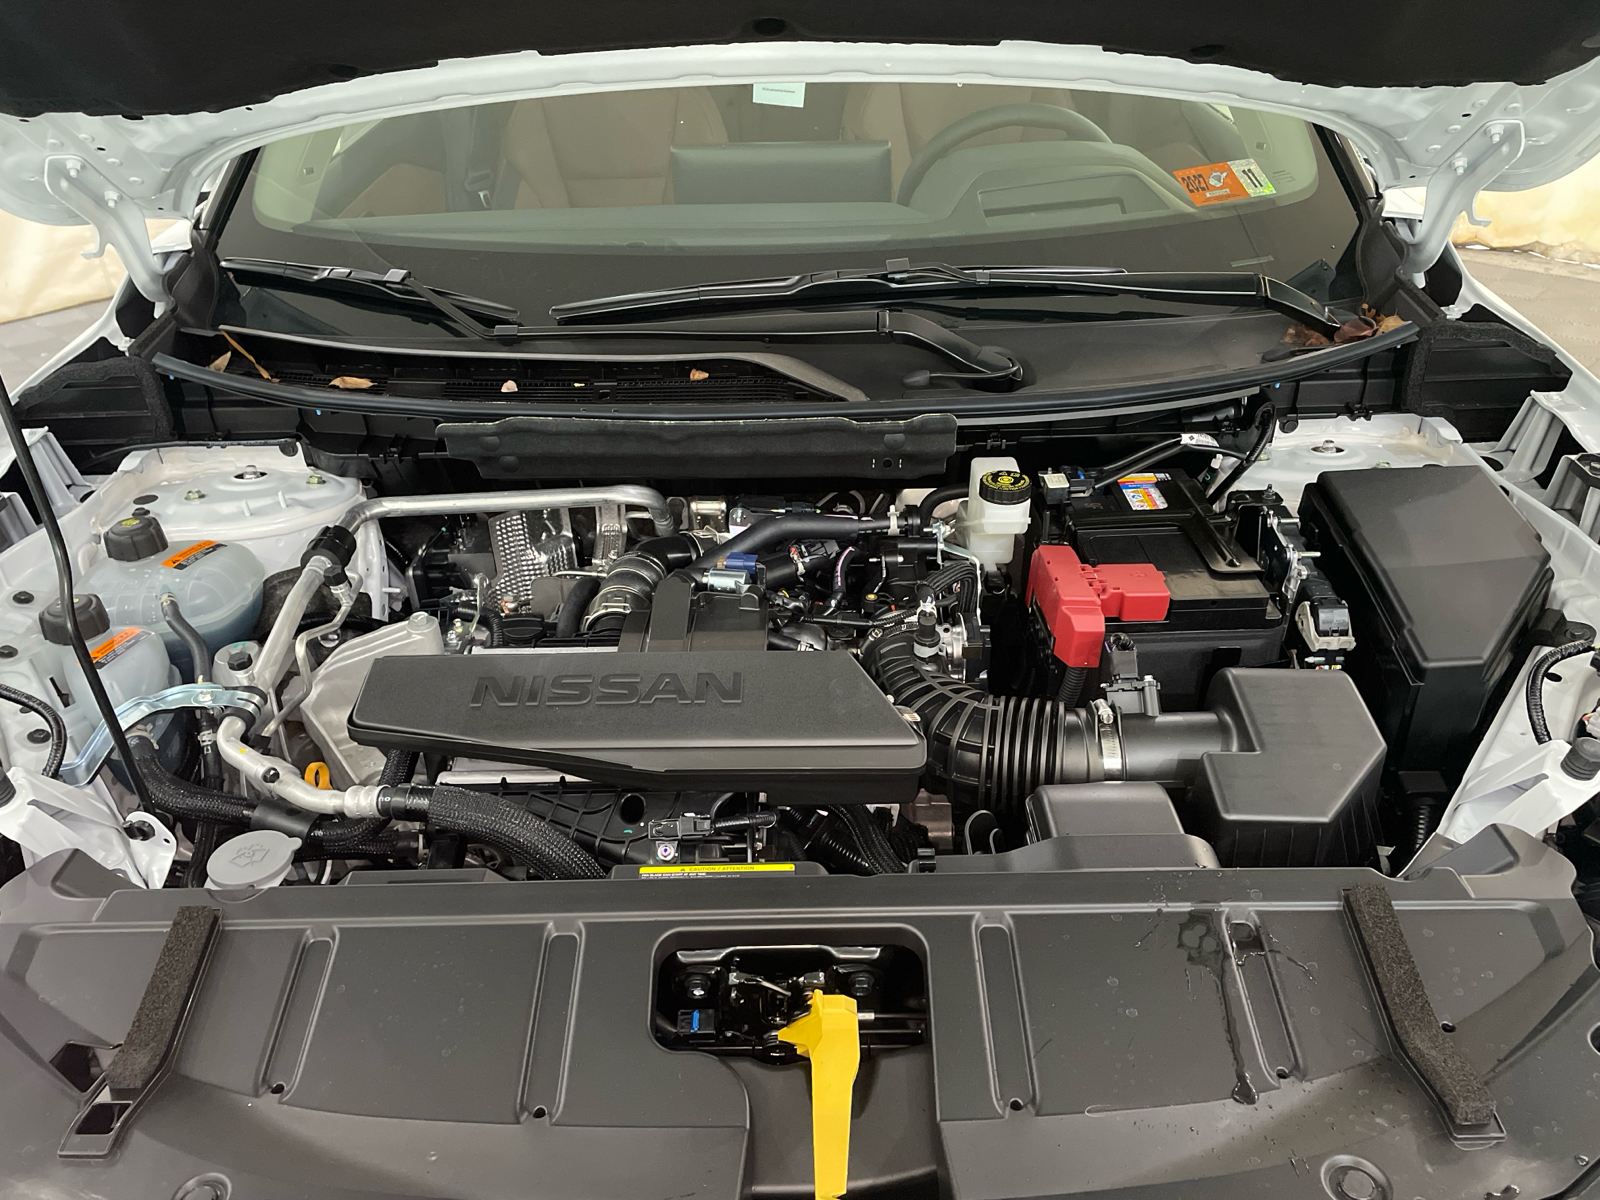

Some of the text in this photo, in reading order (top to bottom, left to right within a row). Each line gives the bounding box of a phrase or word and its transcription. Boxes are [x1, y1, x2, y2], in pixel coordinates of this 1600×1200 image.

[1181, 173, 1209, 194] 2027
[1242, 168, 1263, 188] 11
[470, 671, 743, 708] NISSAN
